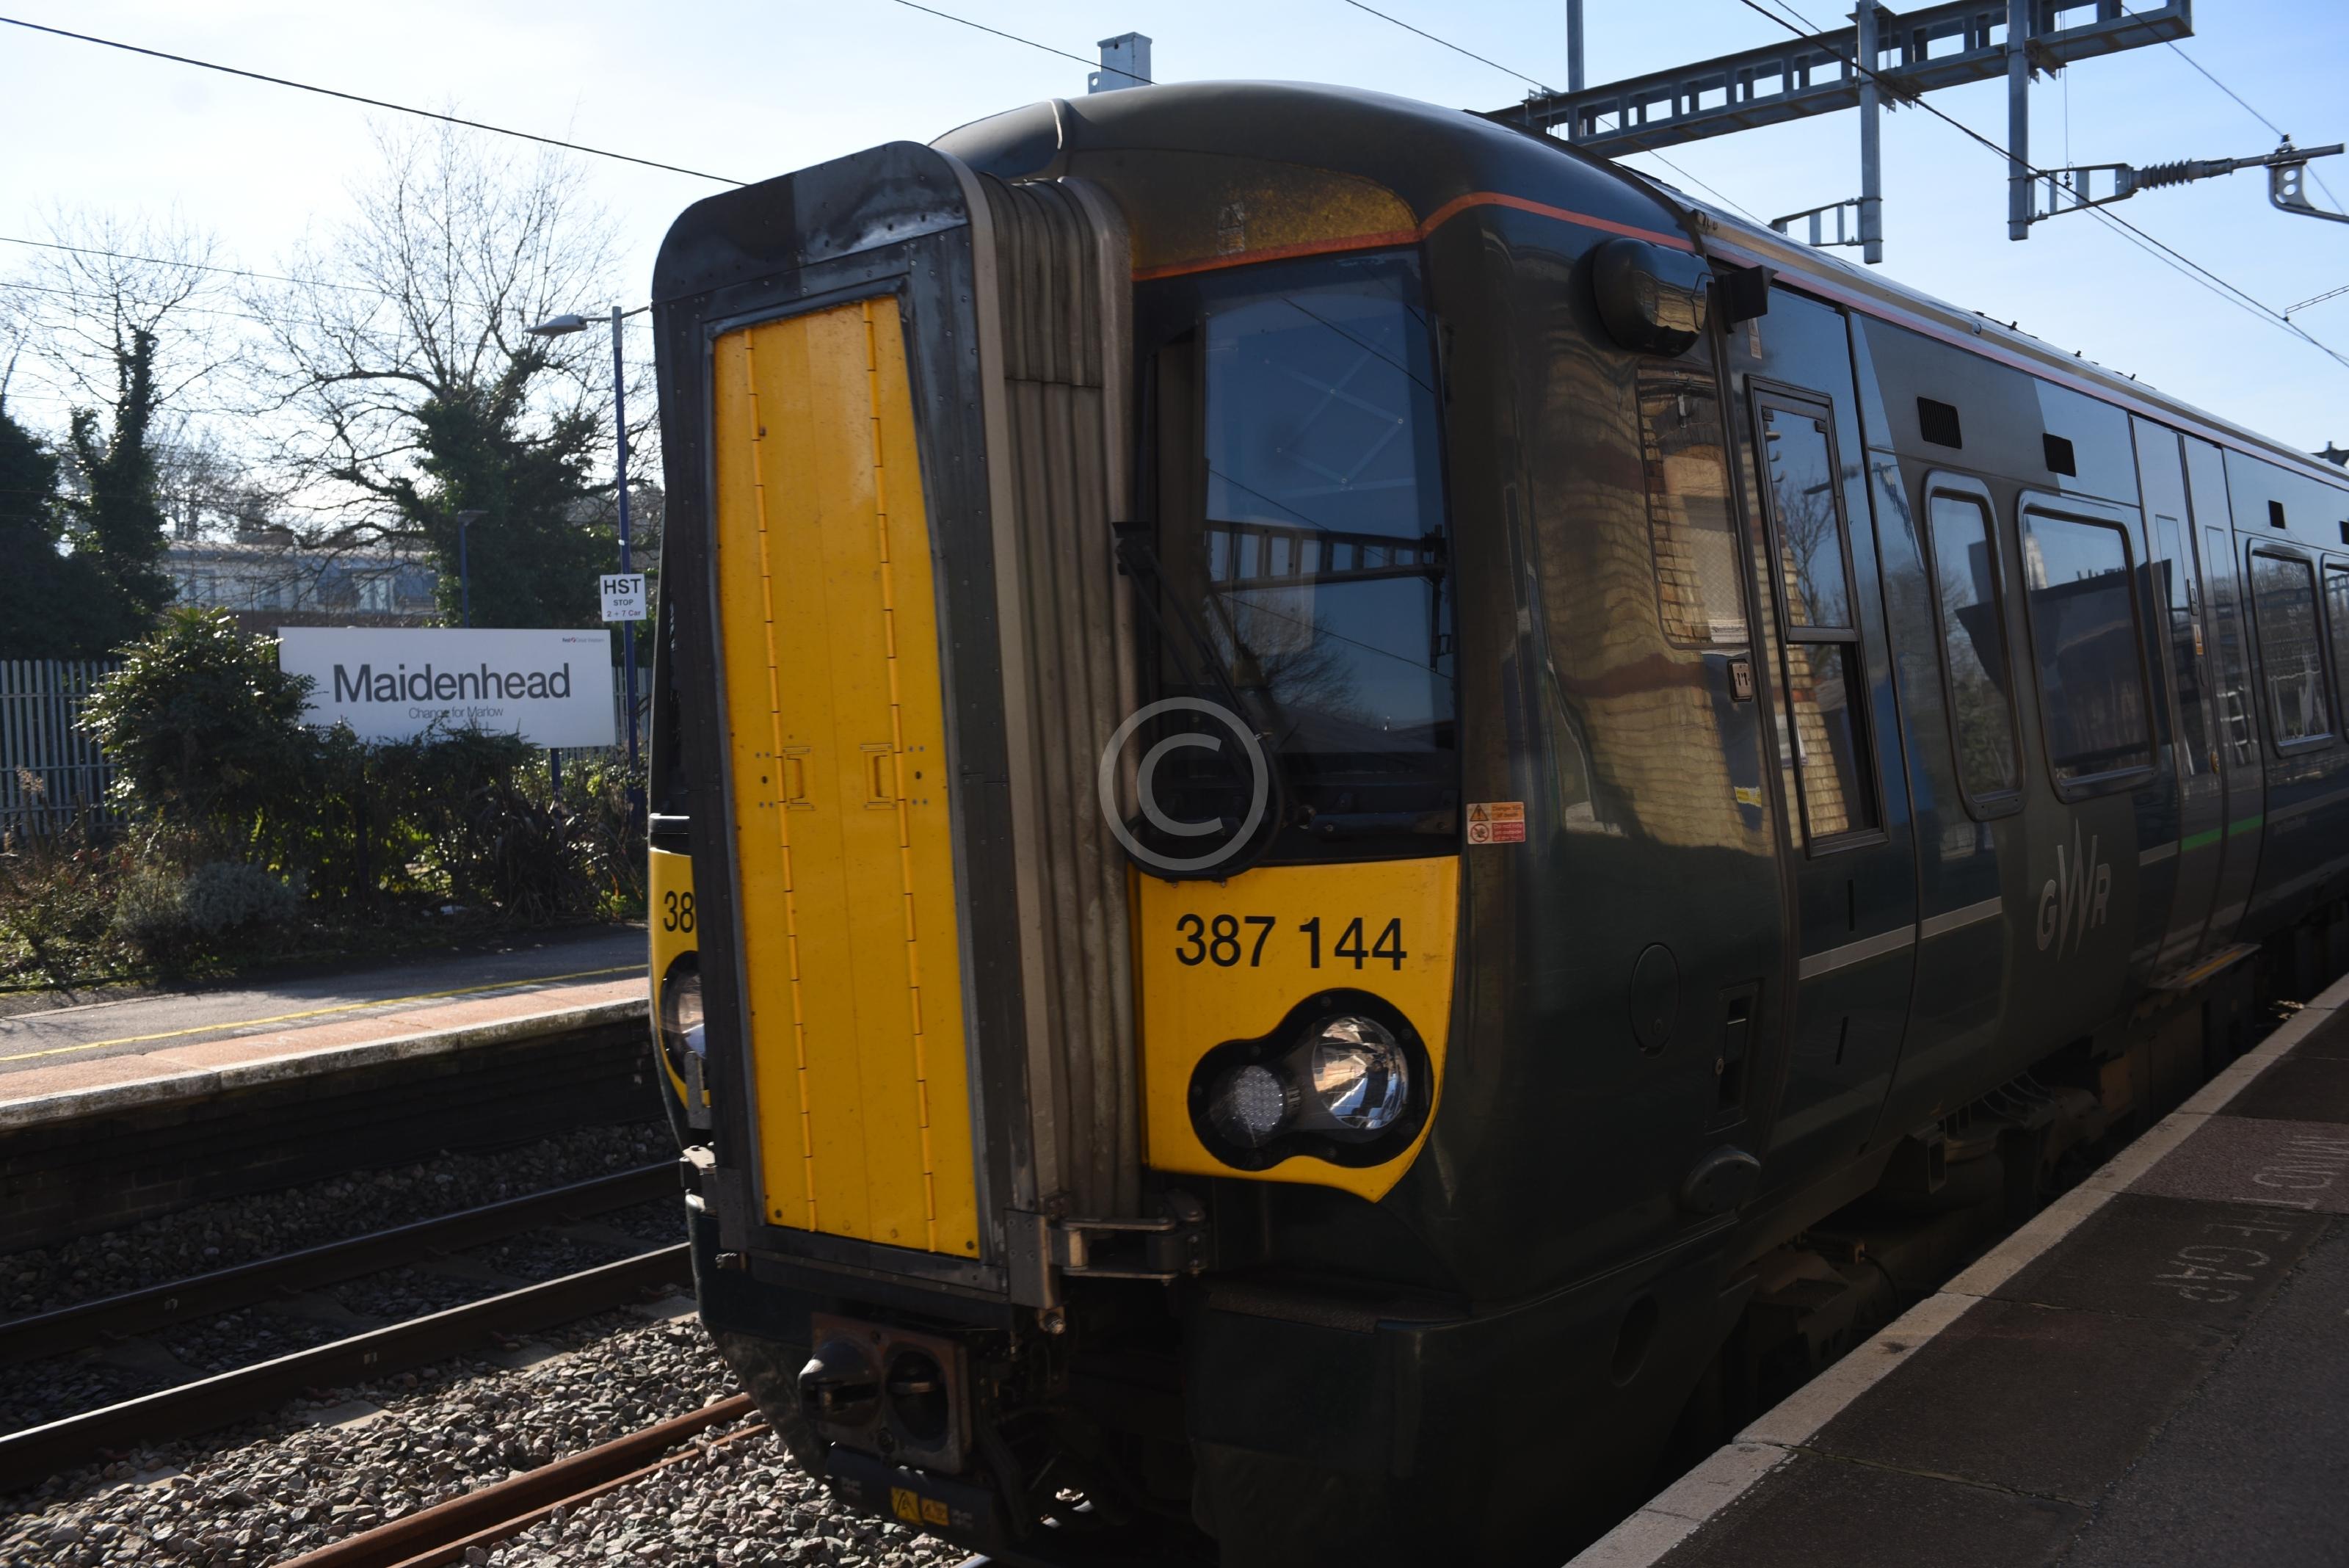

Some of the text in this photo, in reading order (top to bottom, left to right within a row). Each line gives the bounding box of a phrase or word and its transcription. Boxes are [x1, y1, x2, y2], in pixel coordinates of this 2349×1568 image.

[604, 578, 641, 595] HST
[333, 662, 570, 703] Maidenhead
[451, 705, 465, 718] for
[467, 705, 504, 718] Marlow
[663, 890, 694, 933] 38
[2037, 817, 2111, 963] GWR
[1175, 914, 1407, 970] 387 144
[2151, 1244, 2271, 1303] GAP
